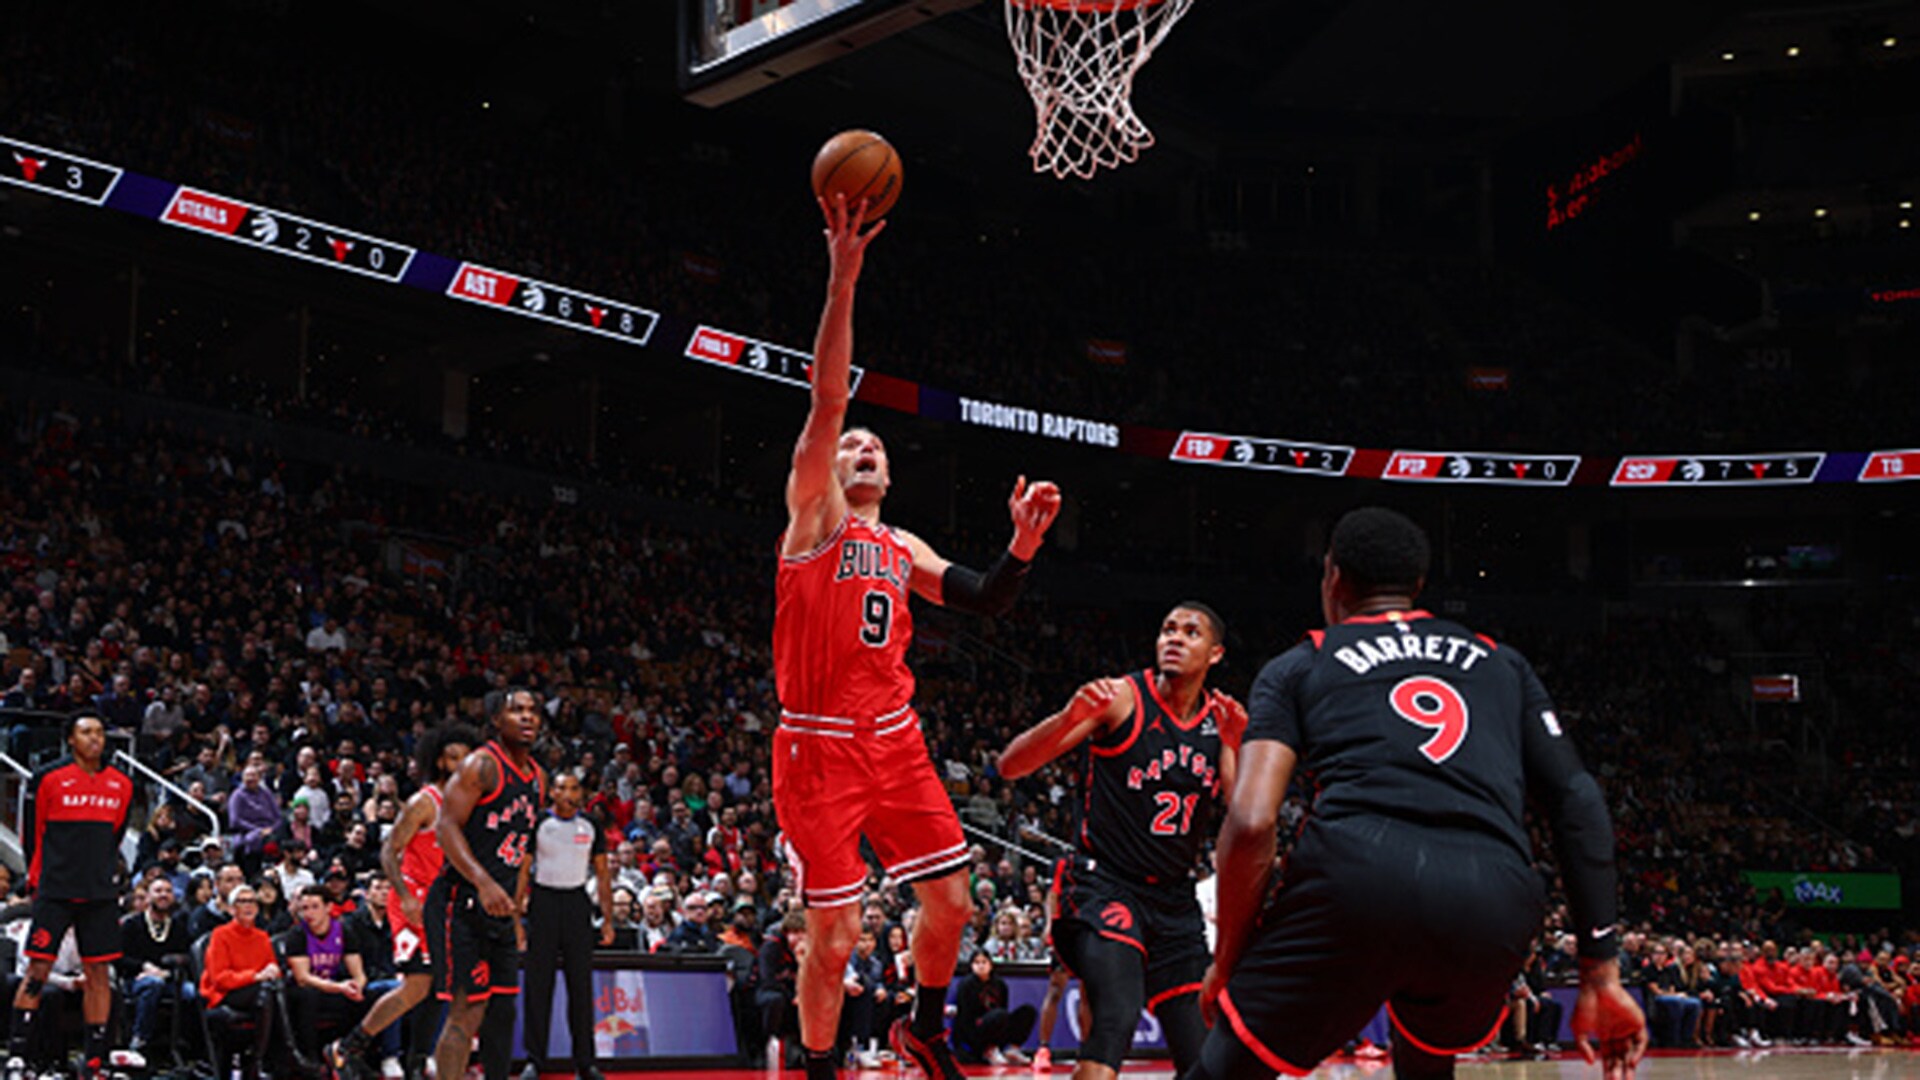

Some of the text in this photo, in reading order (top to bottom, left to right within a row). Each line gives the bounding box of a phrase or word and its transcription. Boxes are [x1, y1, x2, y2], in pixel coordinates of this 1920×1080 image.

[66, 167, 84, 189] 3
[178, 200, 384, 269] STEALS 2 0
[465, 272, 633, 332] AST 6 8
[781, 357, 789, 374] 1
[959, 397, 1119, 447] TORONTO RAPTORS
[1266, 446, 1278, 463] 7
[1321, 452, 1333, 470] 2
[1484, 460, 1497, 476] 2
[1544, 462, 1556, 479] 0
[1719, 462, 1731, 478] 7
[1785, 460, 1798, 476] 5
[1881, 458, 1903, 474] TO
[860, 590, 893, 648] 9
[1334, 634, 1488, 674] BARRETT
[1389, 676, 1469, 764] 9
[1150, 791, 1200, 835] 21
